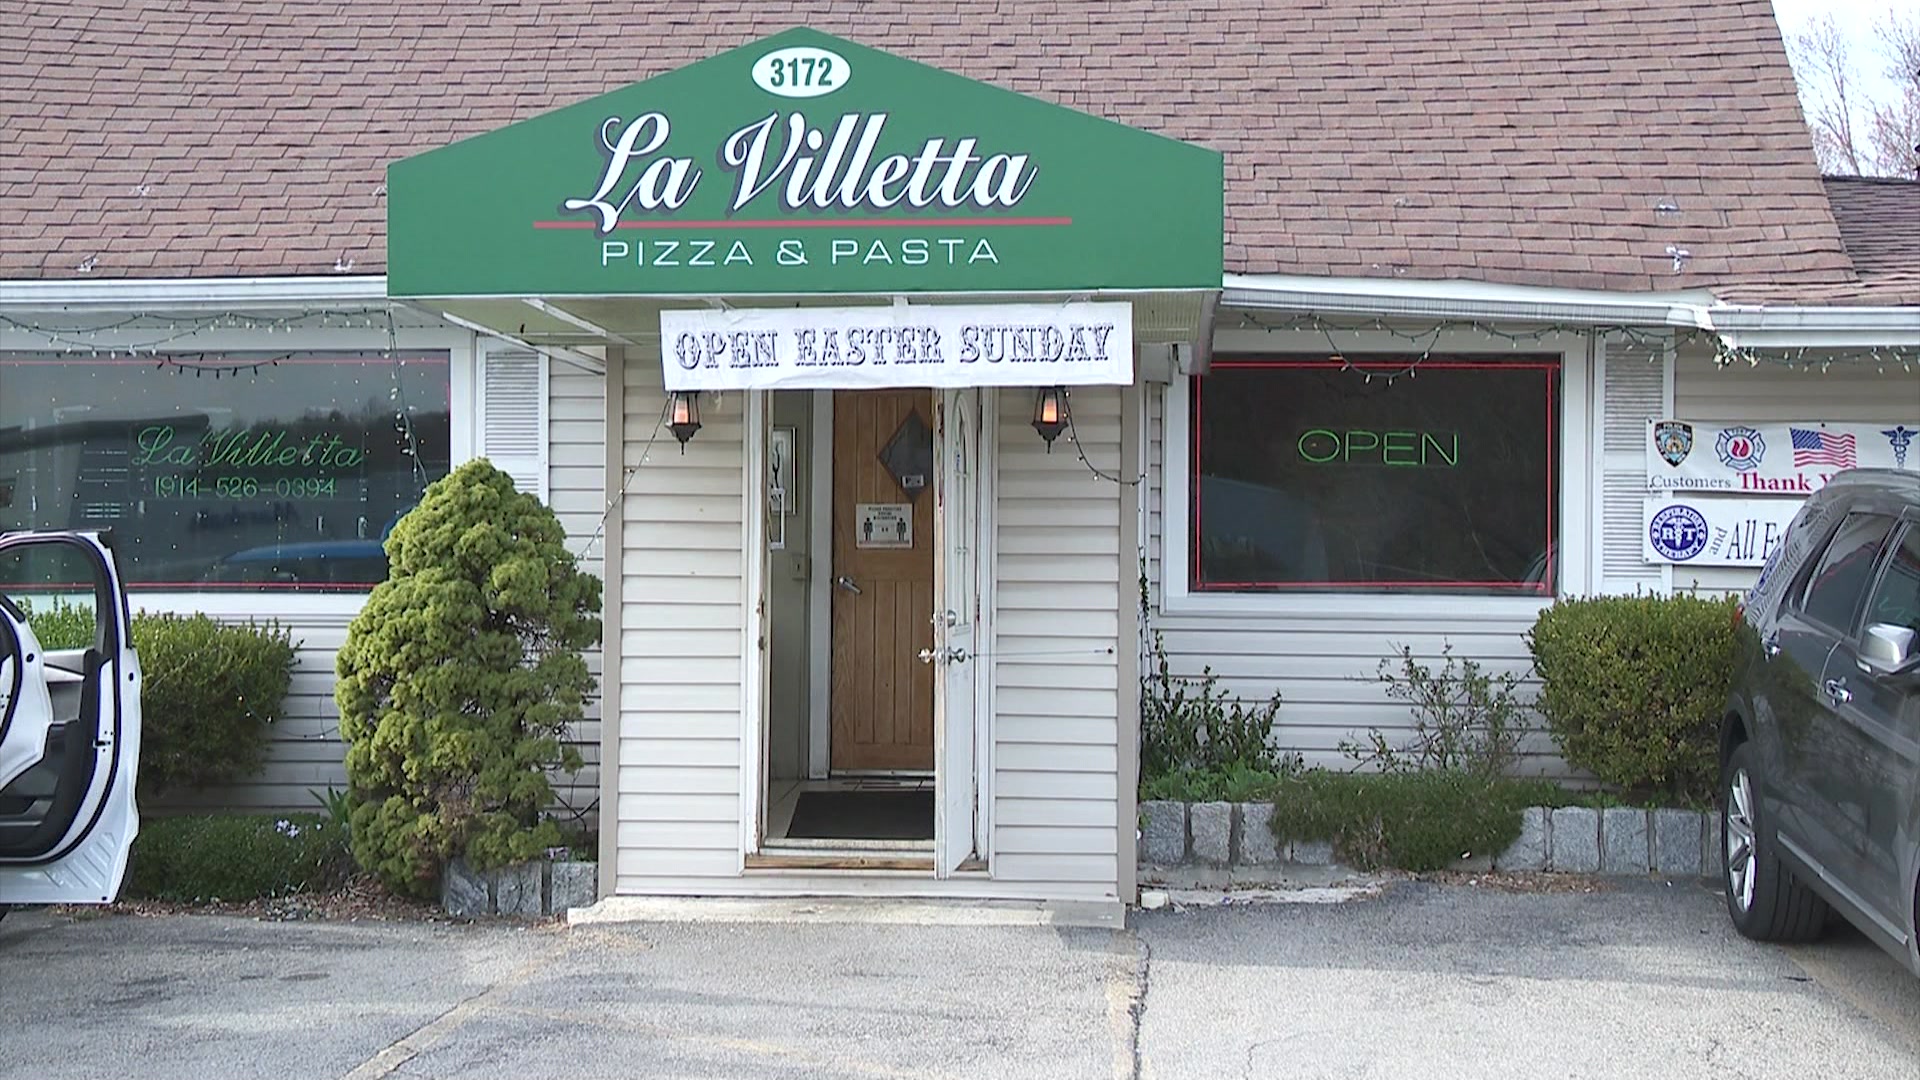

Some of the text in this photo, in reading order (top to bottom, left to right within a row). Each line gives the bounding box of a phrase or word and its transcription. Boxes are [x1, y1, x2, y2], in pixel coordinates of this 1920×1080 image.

[769, 56, 833, 88] 3172
[562, 110, 1039, 233] La Villetta
[601, 238, 999, 266] PIZZA & PASTA
[674, 323, 1115, 370] OPEN EASTER SUNDAY
[131, 425, 364, 467] La Villetta
[1297, 429, 1460, 466] OPEN
[1651, 475, 1732, 489] Customers
[1735, 471, 1812, 491] Thank
[1709, 526, 1728, 556] and
[1724, 519, 1757, 560] All
